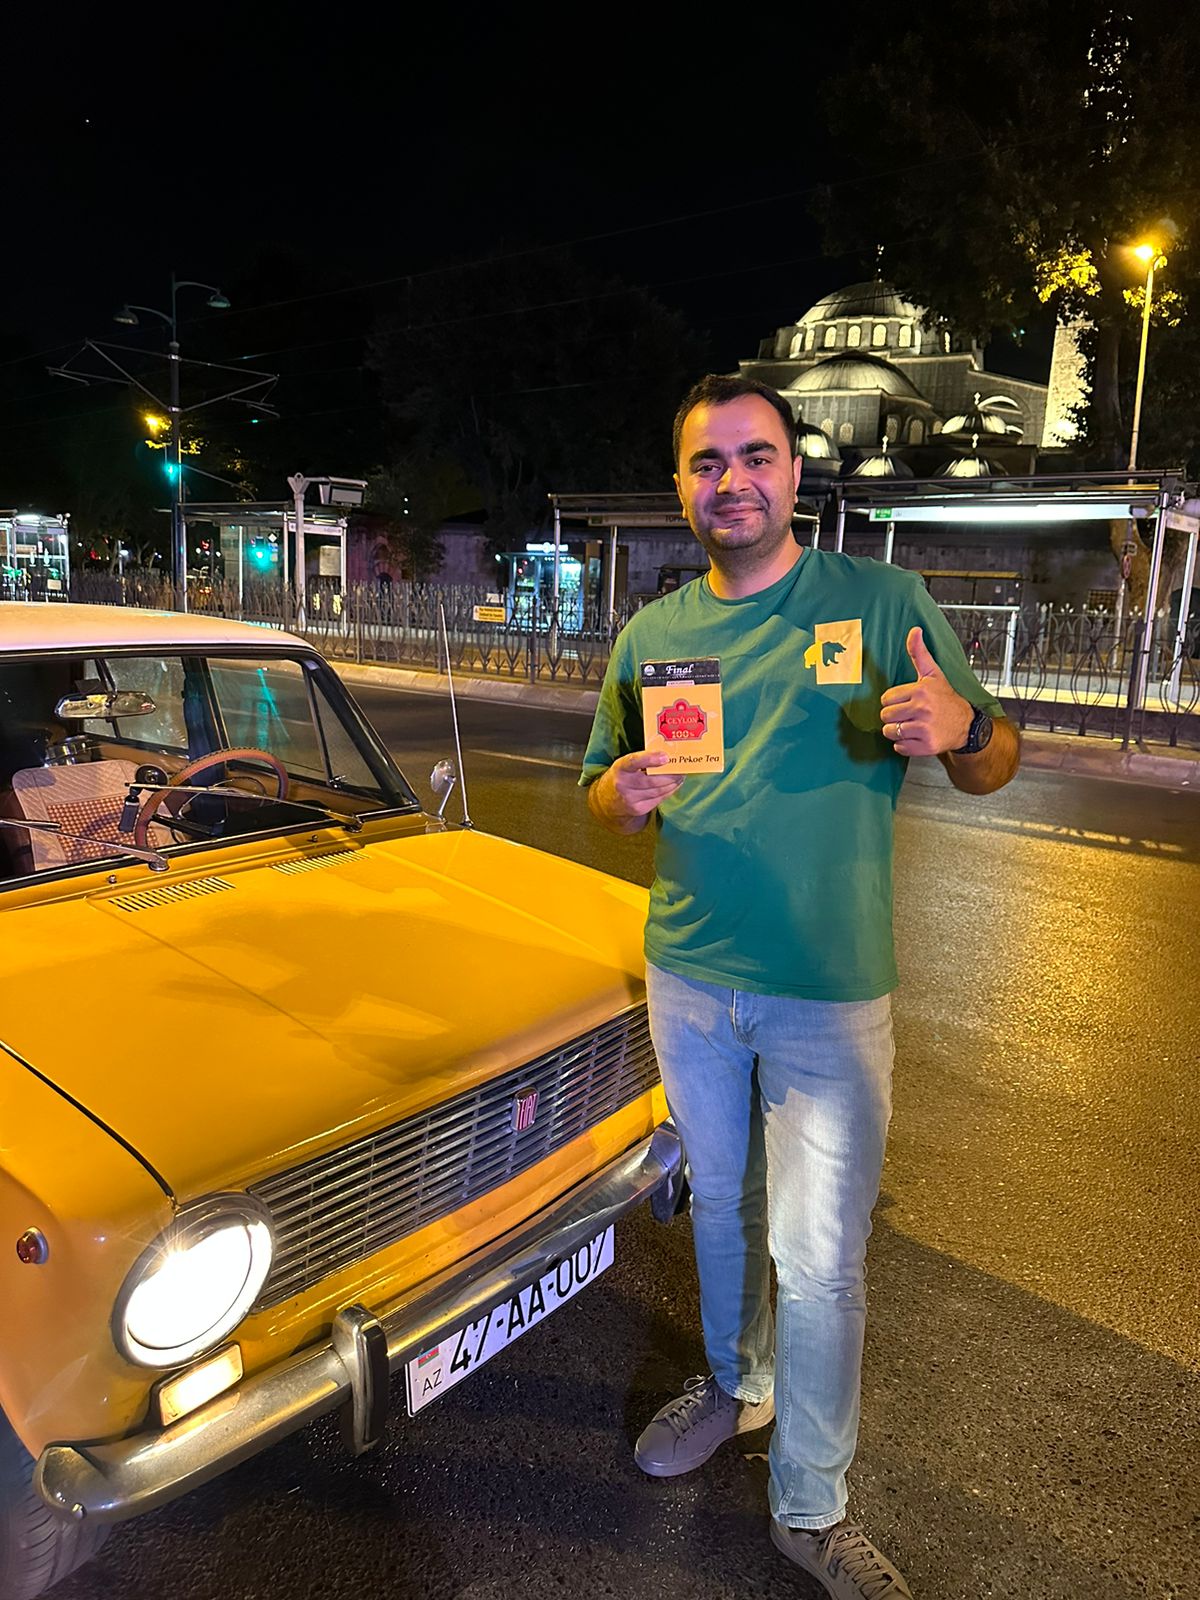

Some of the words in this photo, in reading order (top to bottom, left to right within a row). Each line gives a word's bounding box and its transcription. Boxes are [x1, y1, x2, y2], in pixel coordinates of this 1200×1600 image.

[666, 664, 693, 675] Final
[667, 716, 697, 724] CEYLON
[679, 755, 703, 763] Pekoe
[705, 754, 720, 763] Tea
[421, 1367, 443, 1397] AZ
